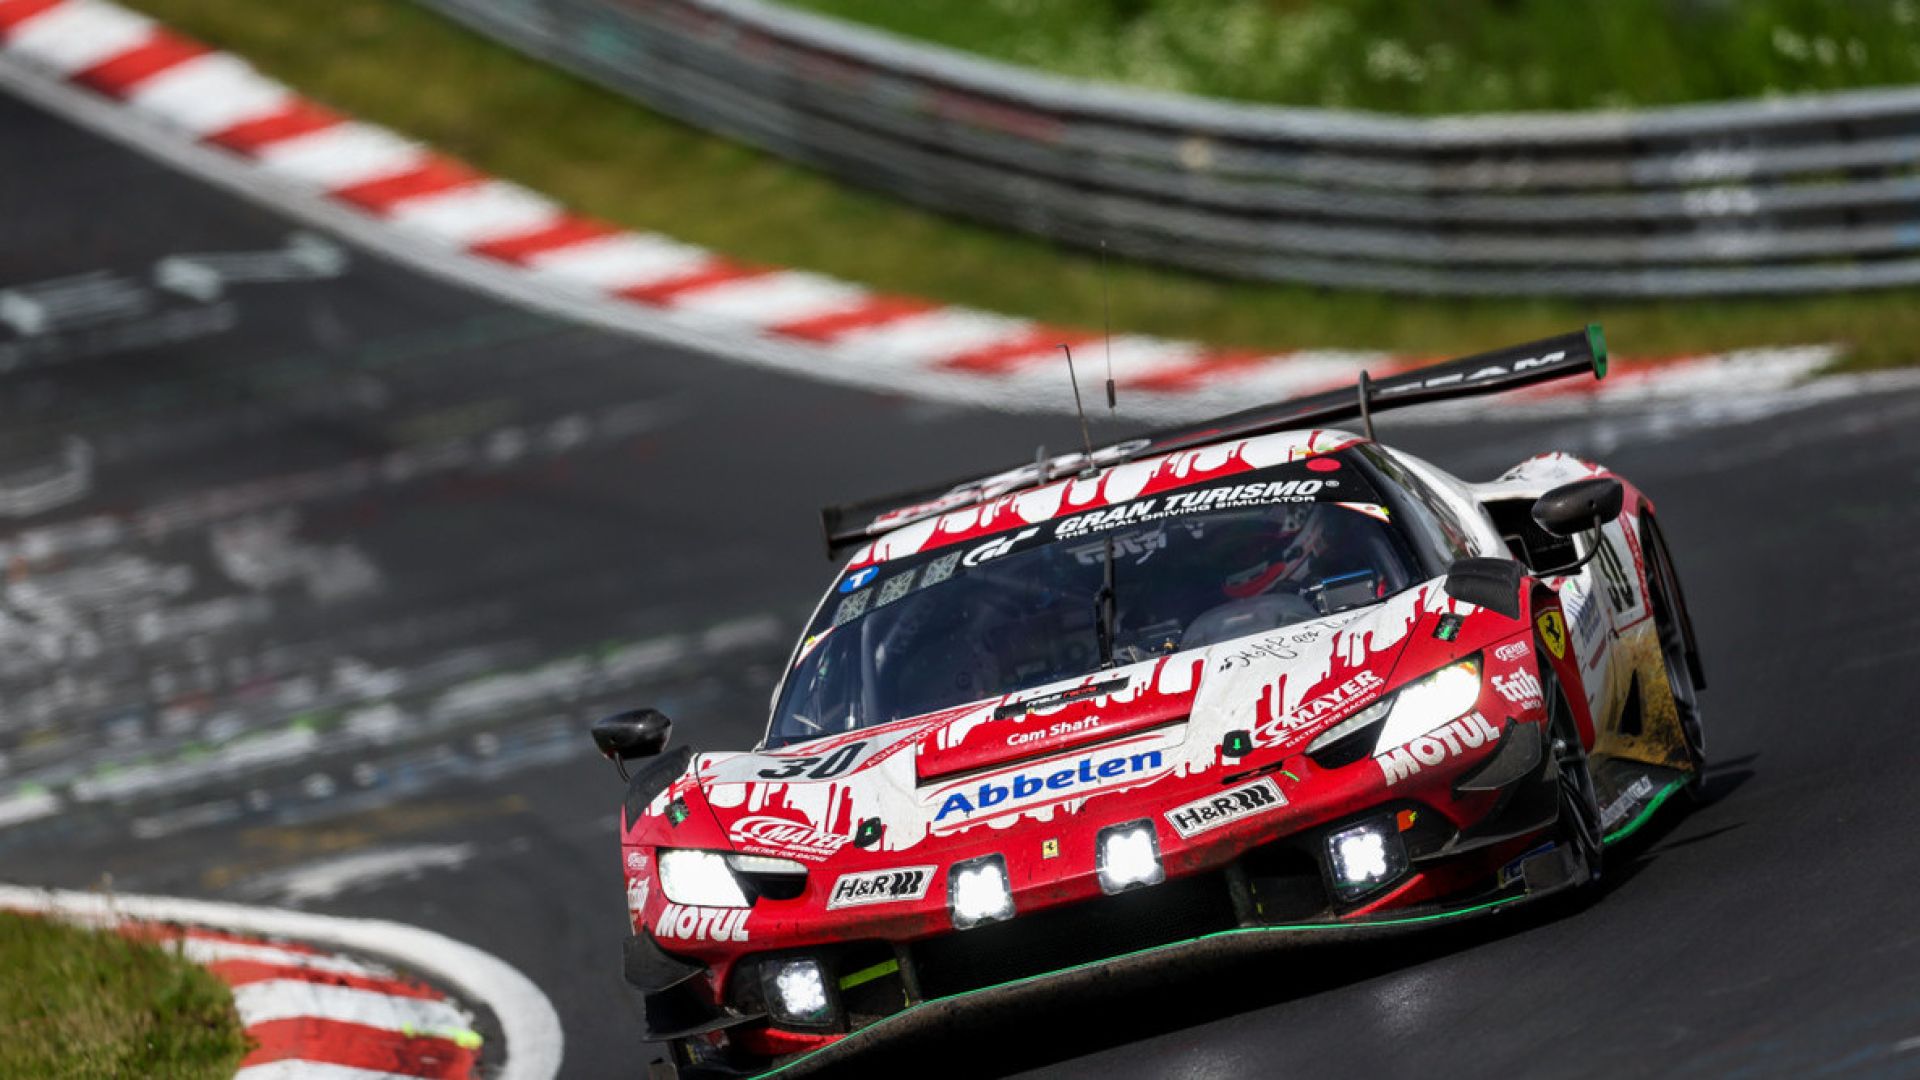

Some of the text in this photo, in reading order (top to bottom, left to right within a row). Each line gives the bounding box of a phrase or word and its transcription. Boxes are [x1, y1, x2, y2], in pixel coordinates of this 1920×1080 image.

[1055, 499, 1156, 535] GRAN
[1093, 517, 1137, 532] REAL
[1140, 503, 1211, 522] DRIVING
[1216, 496, 1315, 509] SIMULATOR
[1007, 716, 1099, 746] Cam Shaft
[1375, 711, 1500, 787] MOTUL
[758, 742, 868, 779] 30
[934, 751, 1162, 821] Abbelen
[1174, 798, 1237, 829] H&R
[836, 875, 889, 899] H&R
[655, 904, 751, 941] MOTUL
